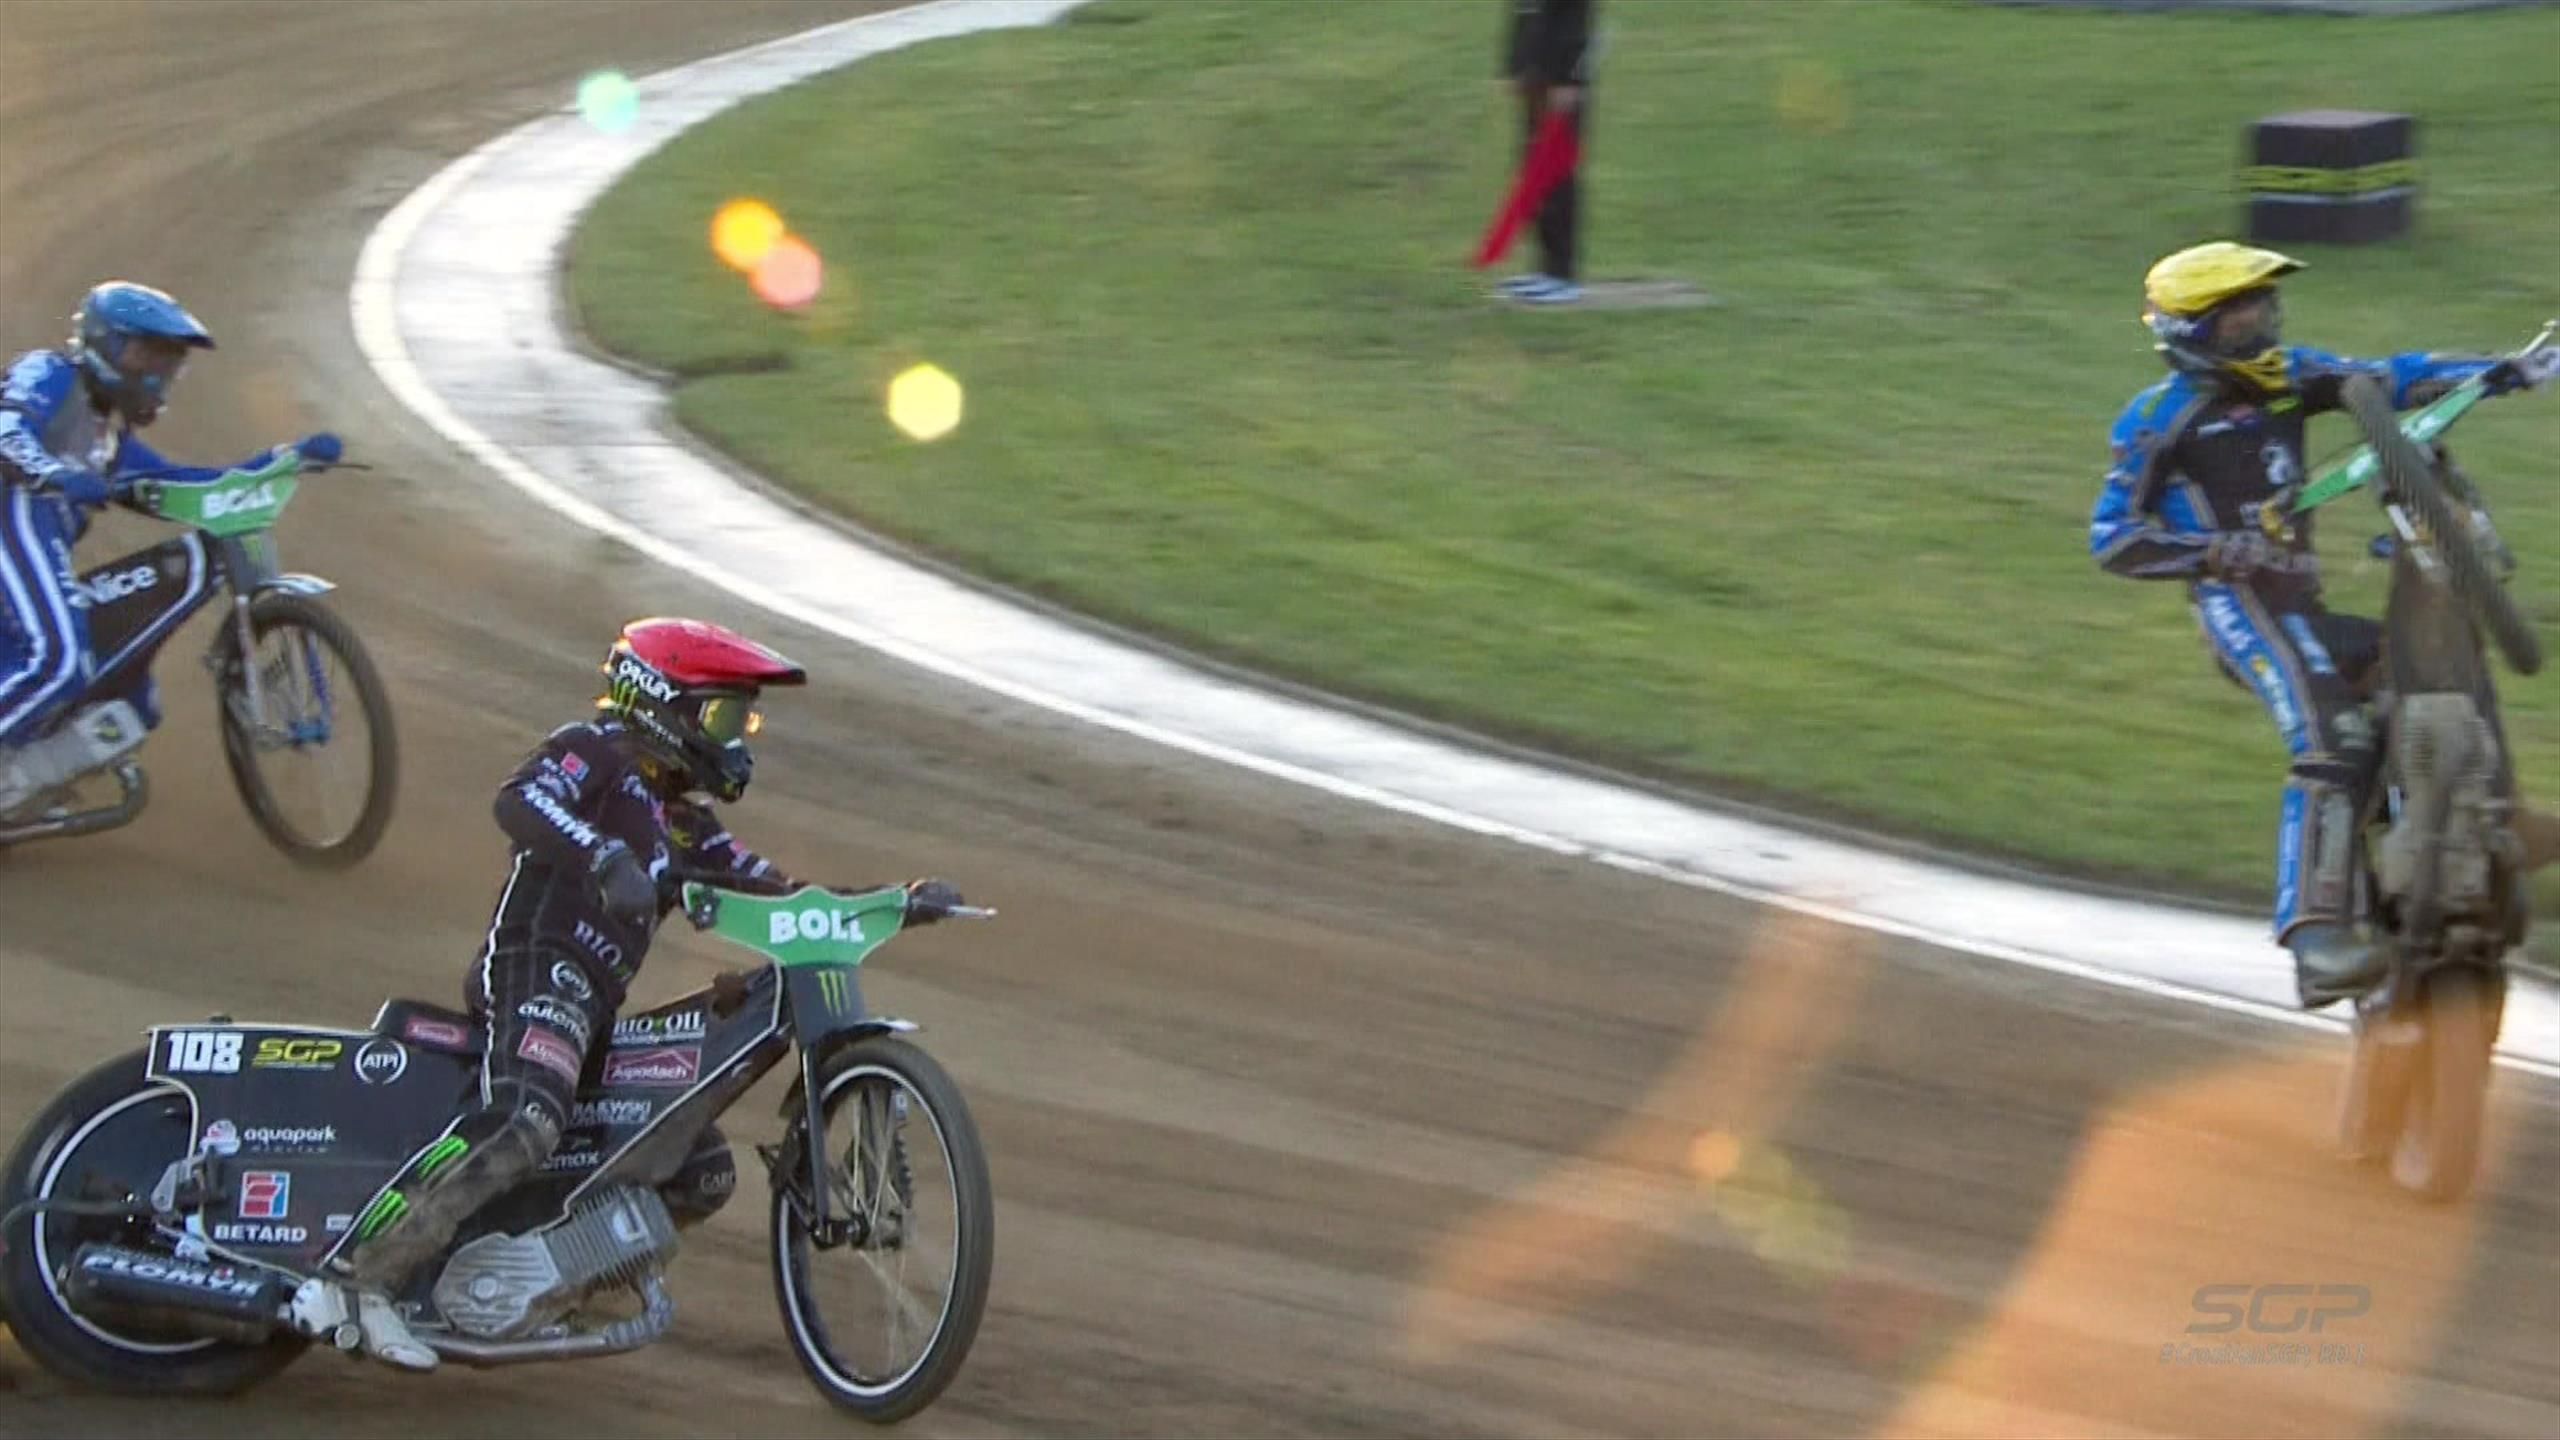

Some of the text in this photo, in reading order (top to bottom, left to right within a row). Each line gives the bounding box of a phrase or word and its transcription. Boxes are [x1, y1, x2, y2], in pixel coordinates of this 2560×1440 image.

[618, 660, 683, 704] OAKLEY
[769, 908, 865, 944] BOLL
[167, 1032, 244, 1073] 108
[256, 1038, 341, 1062] SGP
[243, 1124, 336, 1143] aquapark
[214, 1224, 308, 1243] BETARD
